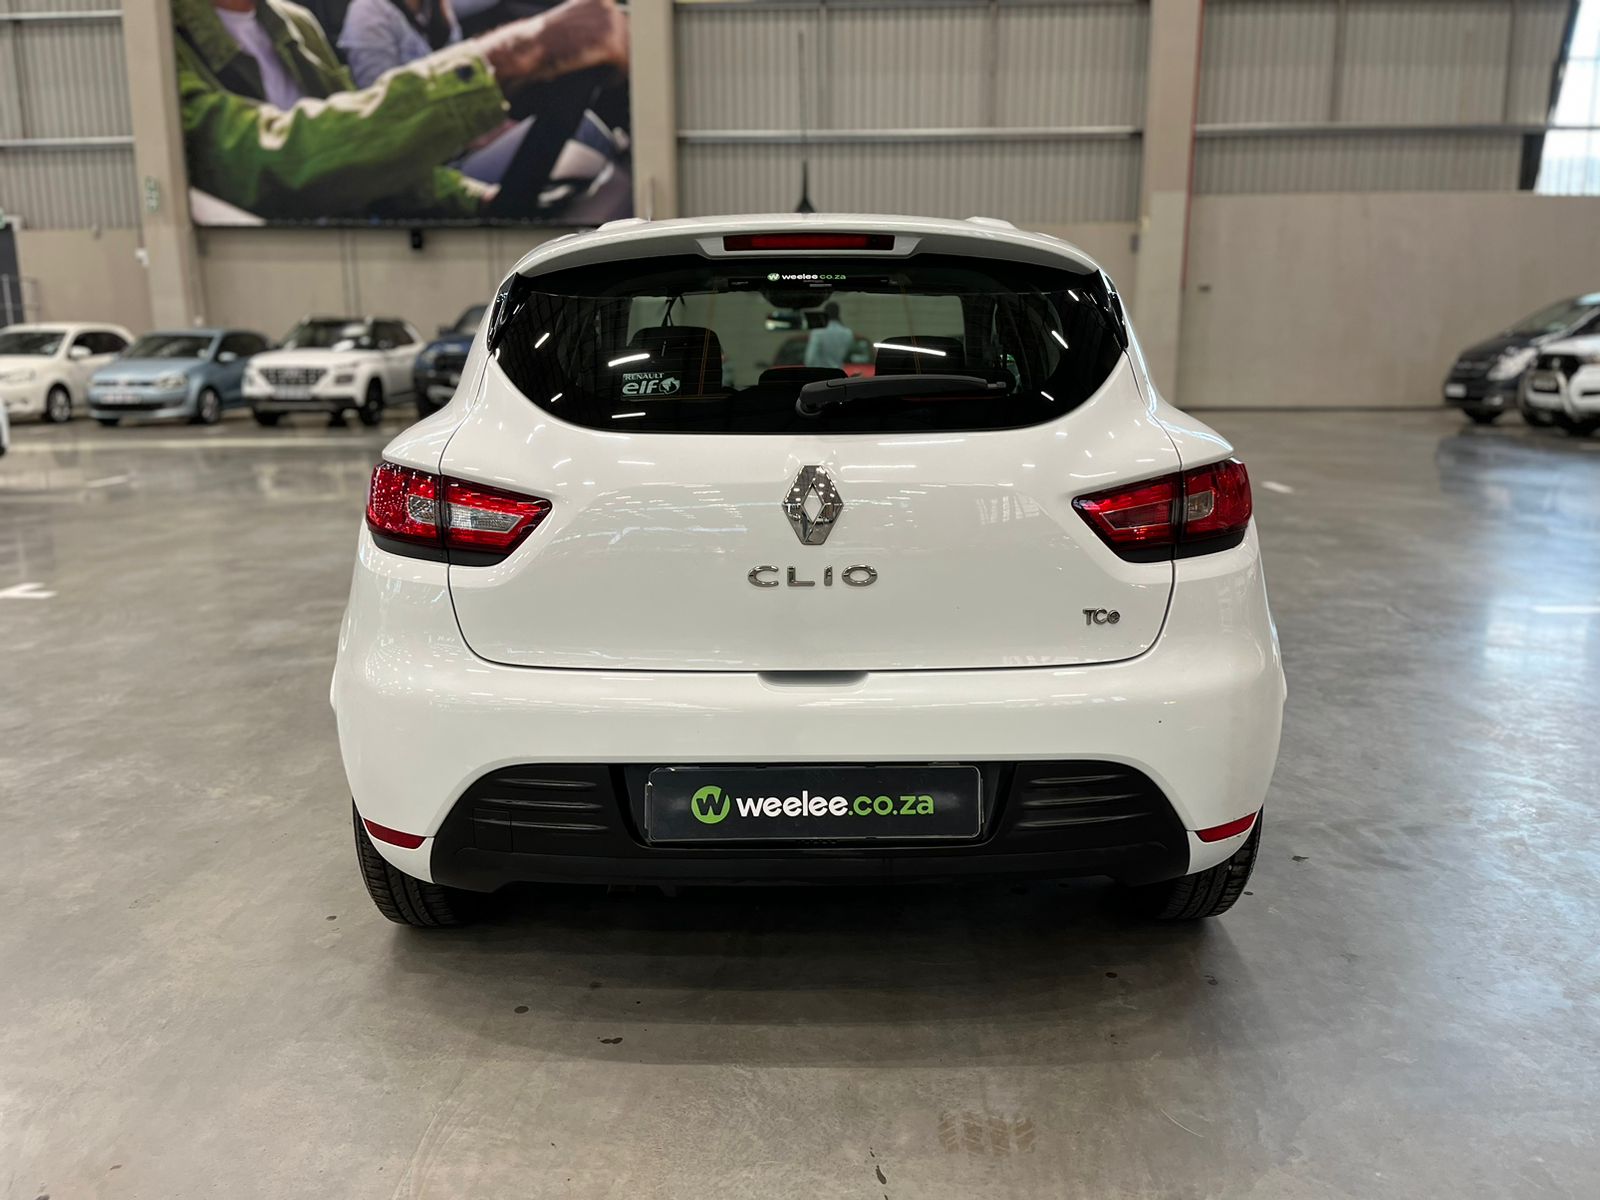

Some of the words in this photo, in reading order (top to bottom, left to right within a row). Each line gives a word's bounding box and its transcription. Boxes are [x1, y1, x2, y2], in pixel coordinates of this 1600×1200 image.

[624, 373, 664, 381] RENAULT
[622, 380, 659, 394] elf
[748, 565, 878, 587] CLIO
[1083, 608, 1120, 625] TCe
[736, 791, 934, 817] weelee.co.za
